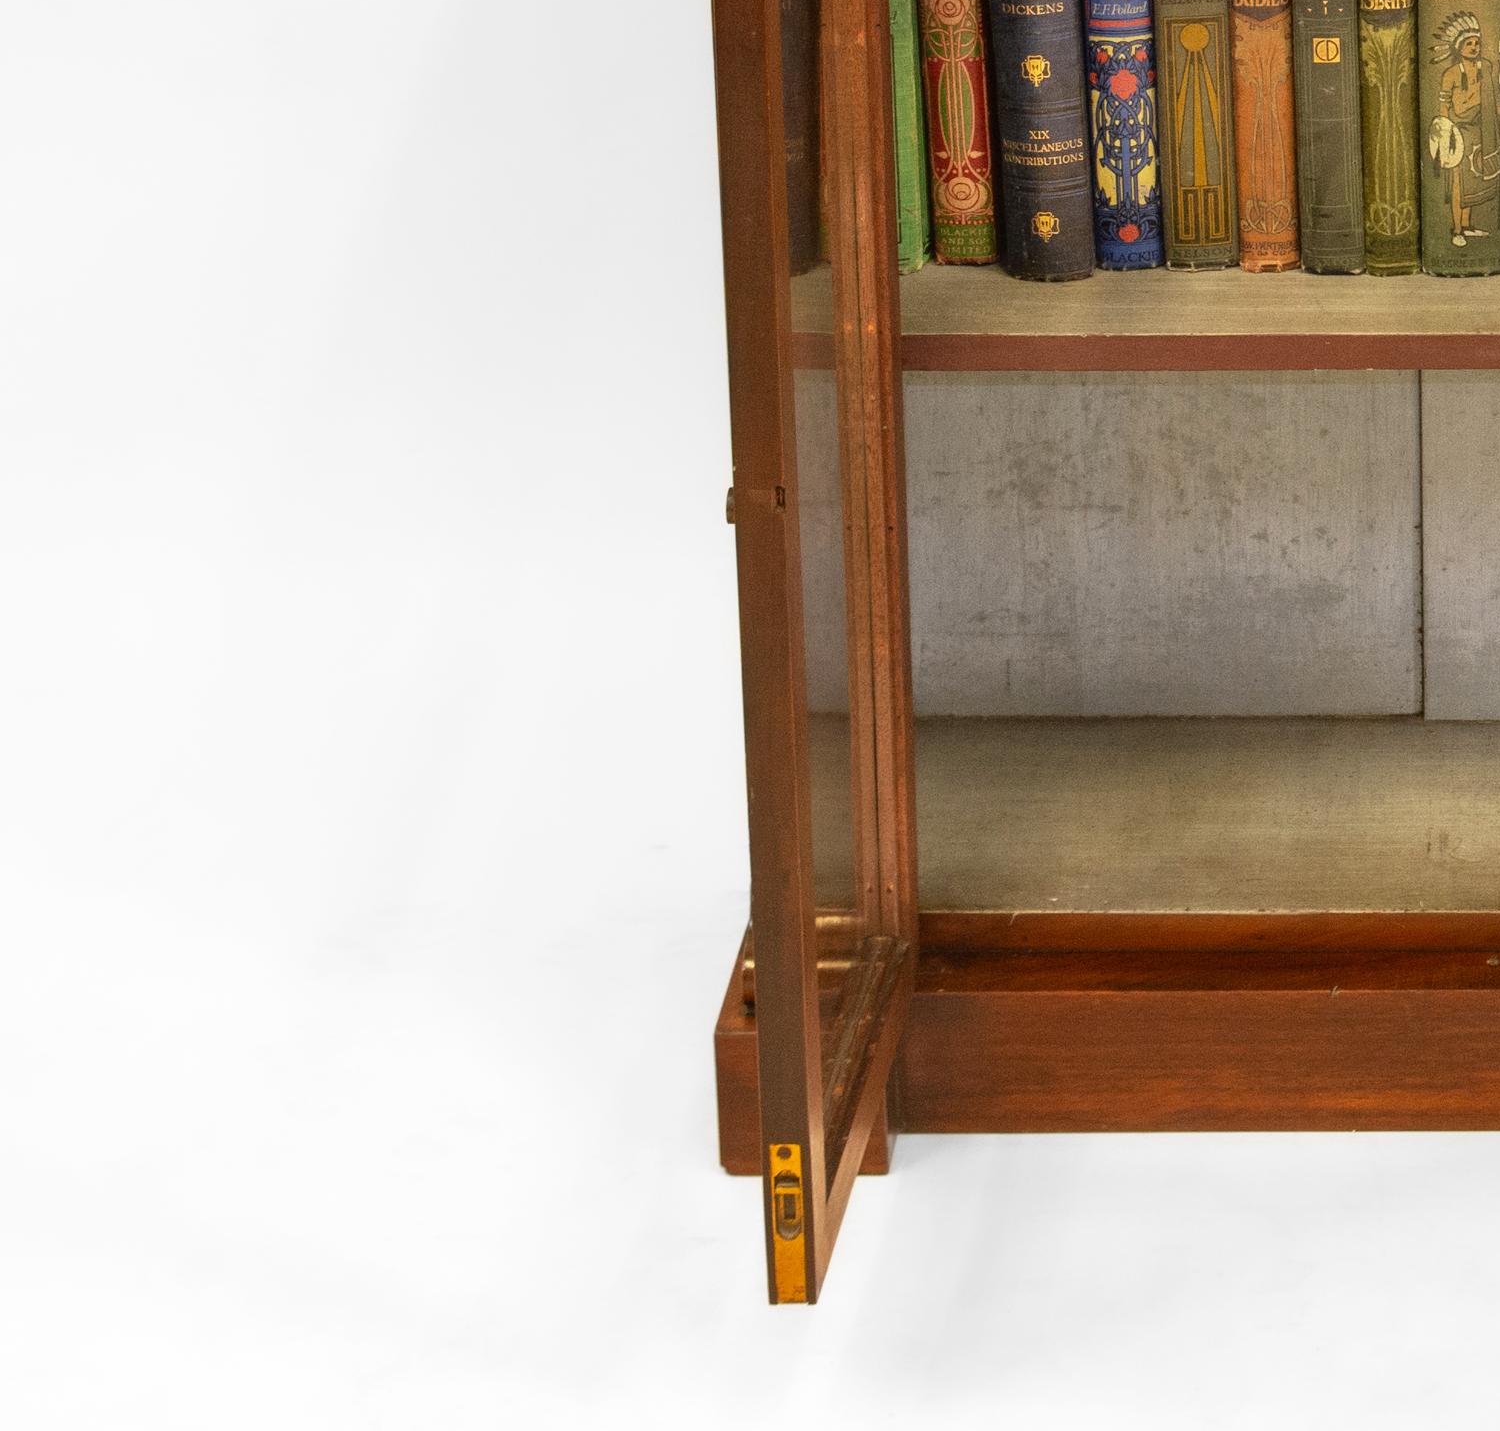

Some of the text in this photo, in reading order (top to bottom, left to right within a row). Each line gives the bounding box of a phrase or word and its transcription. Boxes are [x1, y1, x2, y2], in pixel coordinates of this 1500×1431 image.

[1001, 1, 1065, 16] DICKENS
[1029, 130, 1050, 140] XIX
[1003, 138, 1084, 153] MISCELLANEOUS
[1004, 152, 1084, 166] CONTRIBUTIONS
